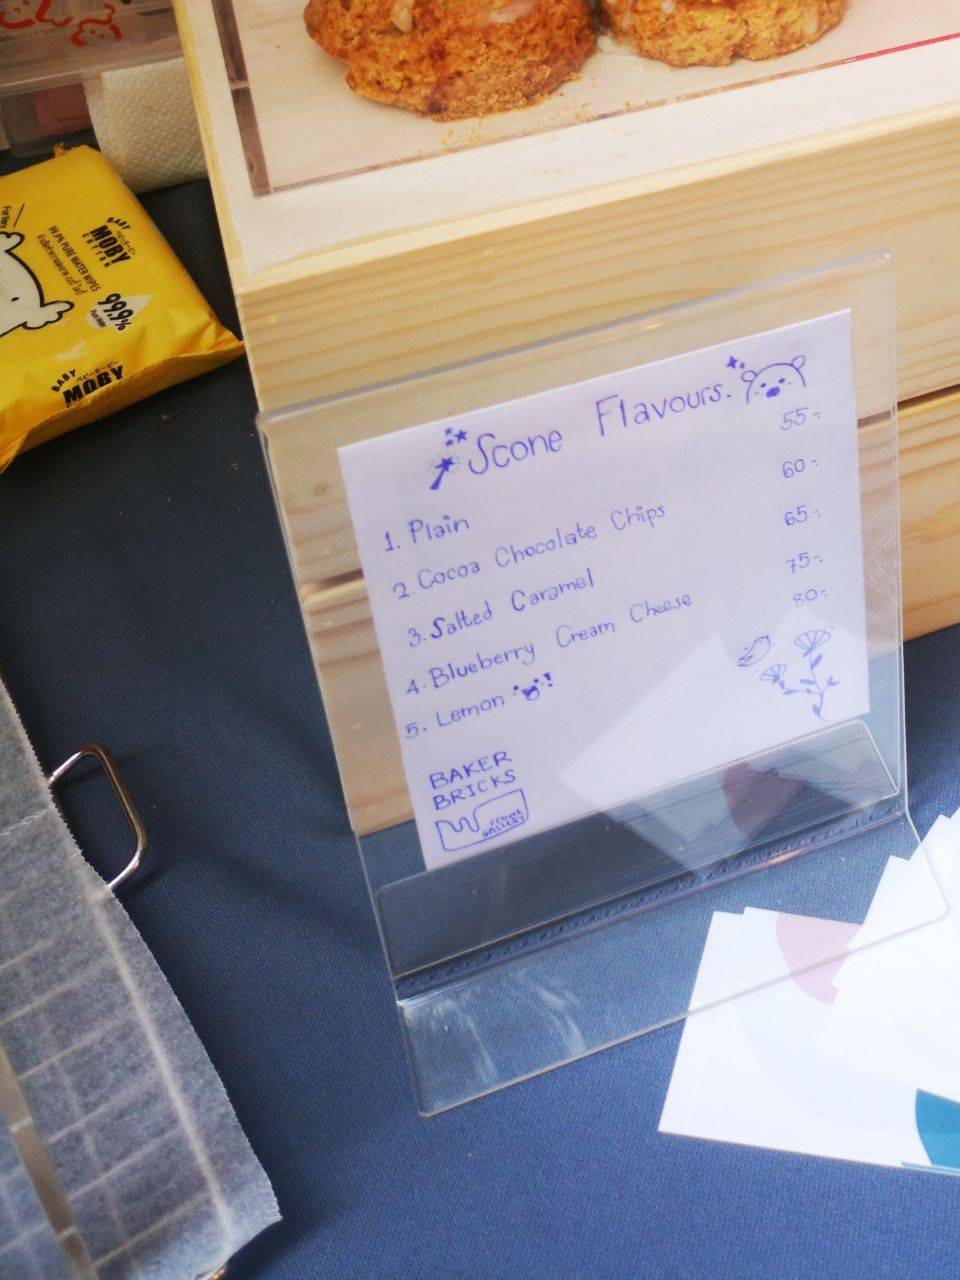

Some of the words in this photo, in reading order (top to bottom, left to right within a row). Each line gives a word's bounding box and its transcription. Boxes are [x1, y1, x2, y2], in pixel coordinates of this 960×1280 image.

[89, 224, 131, 264] MOBY
[62, 241, 76, 257] PURE
[71, 256, 89, 274] WATER
[83, 274, 101, 291] WIPES
[97, 293, 134, 331] 99.9%
[51, 369, 76, 392] BABY
[62, 365, 124, 404] MOBY
[469, 429, 563, 475] Scone
[384, 531, 401, 552] 1.
[408, 514, 470, 544] Plain
[417, 561, 481, 589] Cocoa
[494, 522, 598, 568] Chocolate
[610, 505, 666, 531] Chips
[408, 627, 427, 647] 3.
[430, 600, 492, 639] Salted
[511, 567, 595, 612] Caramel
[428, 643, 536, 689] Blueberry
[555, 622, 616, 648] Cream
[628, 594, 693, 623] Cheese
[405, 721, 427, 739] 5.
[435, 694, 505, 727] Lemon
[429, 751, 512, 789] BAKER
[432, 769, 516, 810] BRICKS
